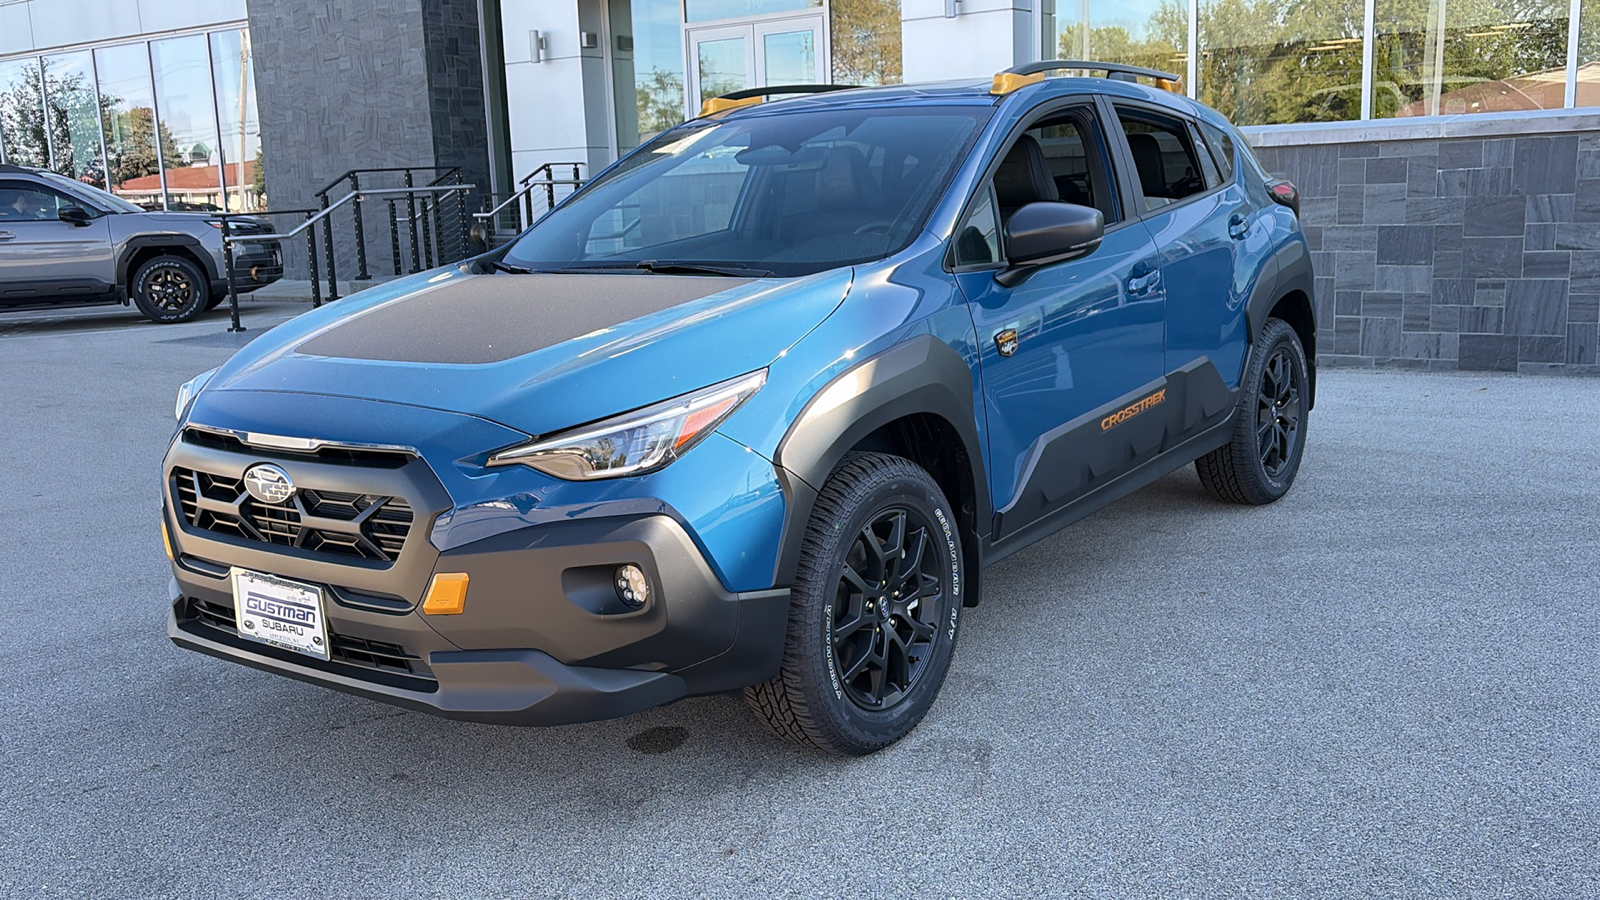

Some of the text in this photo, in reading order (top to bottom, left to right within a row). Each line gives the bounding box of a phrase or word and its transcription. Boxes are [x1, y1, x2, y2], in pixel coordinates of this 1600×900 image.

[1101, 388, 1166, 430] CROSSTREK
[934, 508, 958, 640] GEOLANDAR A/T
[262, 619, 303, 636] SUBARU
[826, 604, 841, 700] YOKOHAMA
